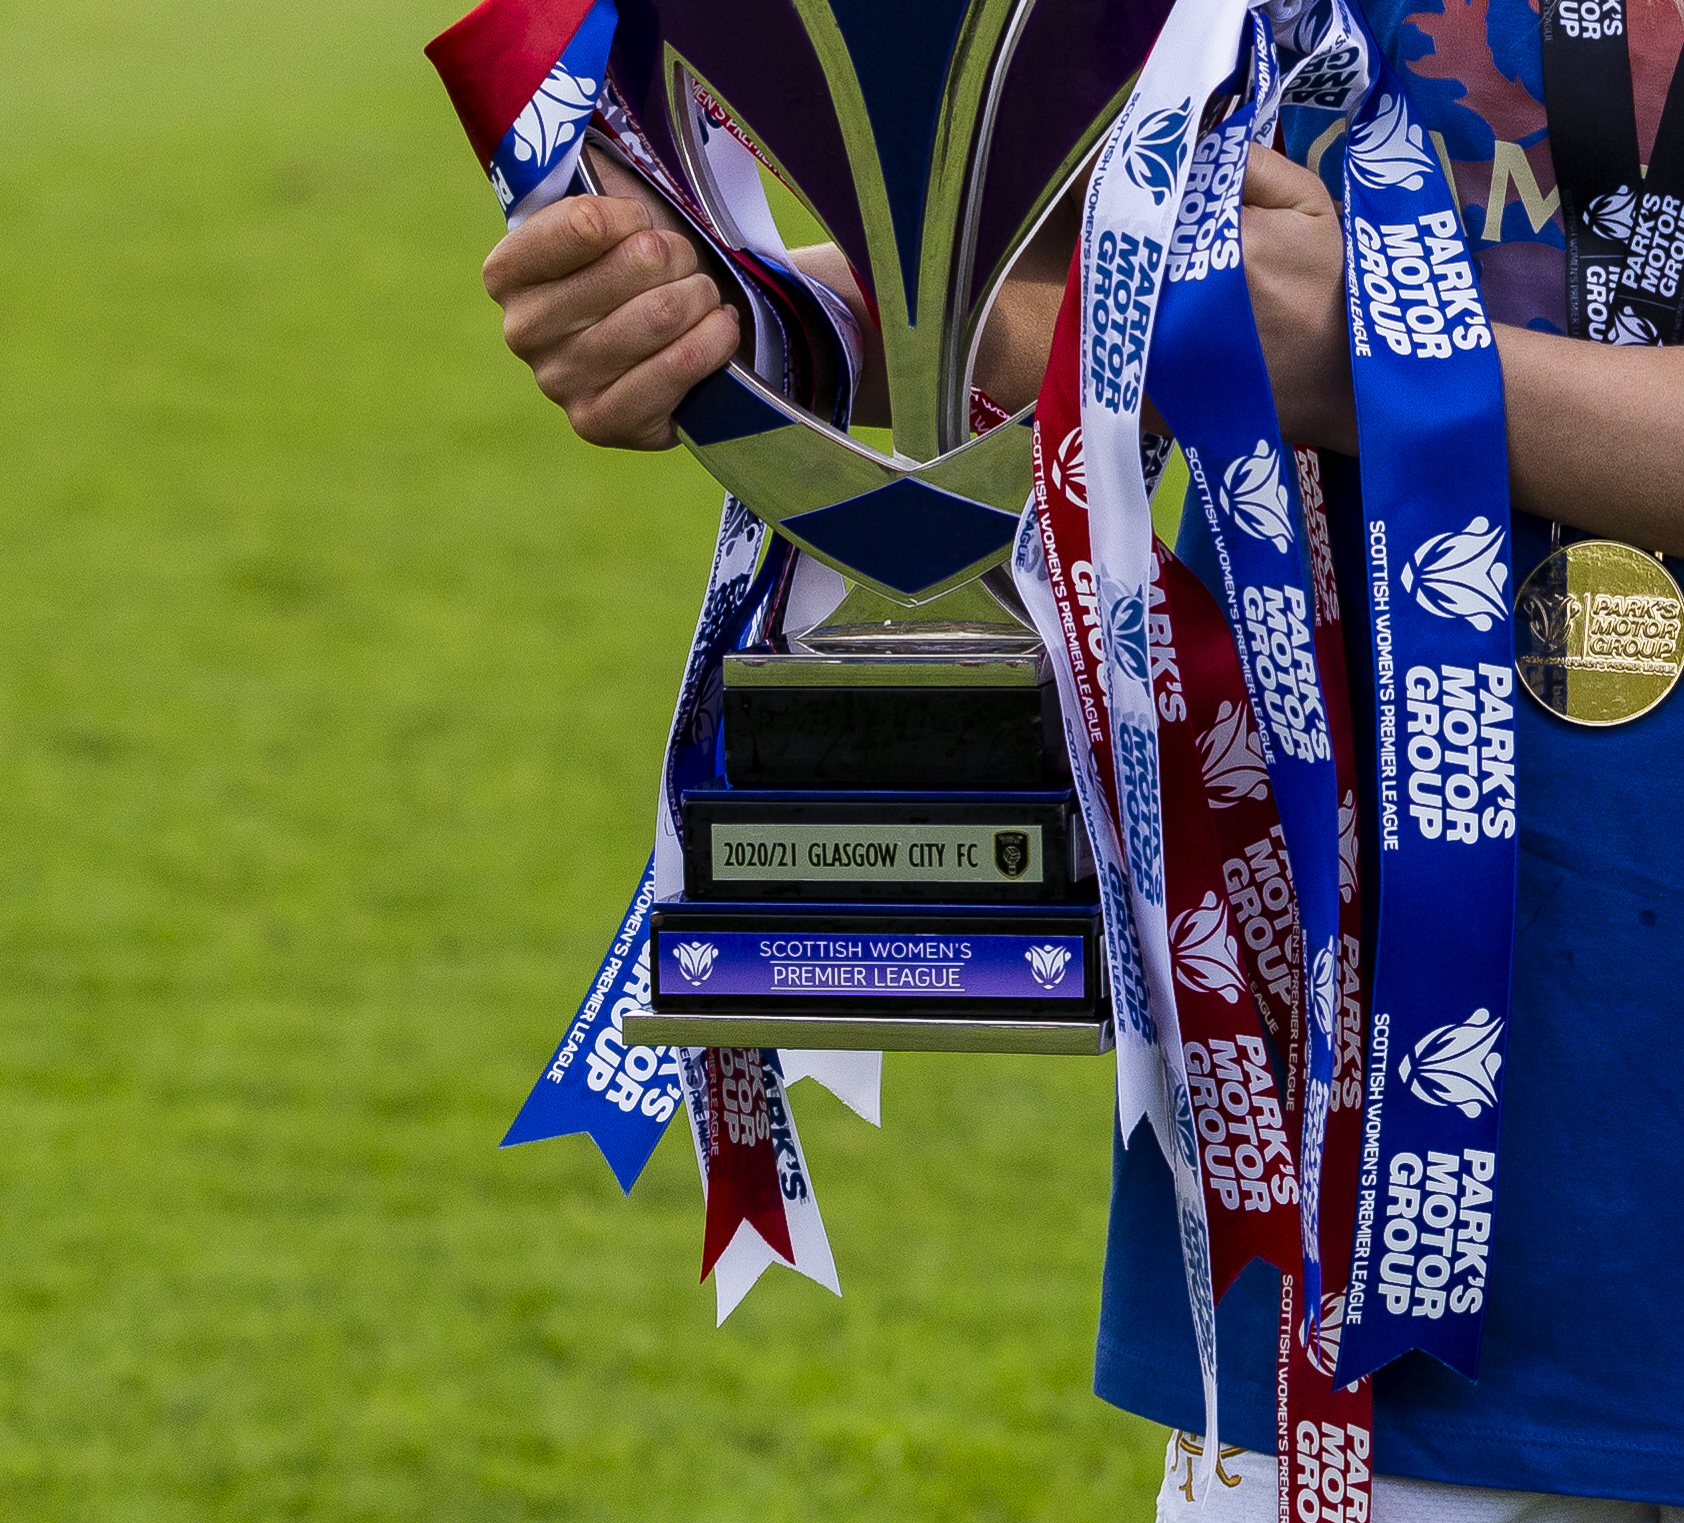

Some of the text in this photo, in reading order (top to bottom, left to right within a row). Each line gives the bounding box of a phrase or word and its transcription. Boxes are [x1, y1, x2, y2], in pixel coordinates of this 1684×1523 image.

[1097, 92, 1142, 172] SCOTTISH
[1184, 126, 1247, 281] MOTOR
[1082, 175, 1105, 261] WOMEN'S
[1166, 133, 1221, 282] GROUP
[1418, 209, 1491, 350] PARK'S
[1621, 192, 1661, 290] PARK'S
[1640, 194, 1681, 294] MOTOR
[1090, 230, 1117, 404] GROUP
[1105, 232, 1140, 415] MOTOR
[1122, 236, 1164, 415] PARK'S
[1350, 297, 1372, 358] LEAGUE
[1354, 216, 1412, 356] GROUP
[1380, 223, 1453, 359] MOTOR
[1586, 265, 1608, 343] GROU
[1033, 420, 1104, 742] SCOTTISH WOMEN'S PREMIER LEAGUE
[1185, 446, 1277, 765] SCOTTISH WOMEN'S PREMIER LEAGUE
[1306, 448, 1340, 621] PARK'S
[1243, 586, 1294, 757] GROUP
[1263, 585, 1315, 764] MOTOR
[1284, 584, 1331, 762] PARK'S
[1589, 637, 1677, 661] GROUP
[1590, 616, 1681, 640] MOTOR
[1593, 594, 1681, 620] PARK'S
[1369, 520, 1399, 852] SCOTTISH WOMEN'S PREMIER LEAGUE
[1405, 665, 1442, 840] GROUP
[1441, 664, 1479, 845] MOTOR
[1479, 662, 1516, 840] PARK'S
[723, 841, 979, 868] 2020/21 GLASGOW CITY FC
[1119, 722, 1144, 895] GROUP
[1131, 725, 1156, 907] MOTOR
[759, 941, 972, 960] SCOTTISH WOMEN'S
[1102, 888, 1115, 960] PREMIER
[1108, 861, 1141, 1040] GROUP
[1222, 858, 1292, 1005] GROUP
[1244, 838, 1292, 963] MOT
[547, 880, 654, 1084] WOMEN'S PREMIER LEAGUE
[773, 966, 961, 987] PREMIER LEAGUE
[1108, 961, 1125, 1033] LEAGUE
[1248, 973, 1279, 1035] EAGUE
[1289, 969, 1300, 1039] PREMIER
[1342, 934, 1362, 1110] PARK'S
[680, 1048, 699, 1085] EN'S
[710, 1089, 720, 1156] LEAGUE
[720, 1048, 740, 1143] OUP
[735, 1048, 755, 1147] TOR
[749, 1048, 770, 1140] RK'S
[1184, 1041, 1240, 1211] GROUP
[1208, 1038, 1271, 1213] MOTOR
[1235, 1034, 1300, 1205] PARK'S
[1286, 1042, 1299, 1112] LEAGUE
[1347, 1013, 1390, 1325] SCOTTISH WOMEN'S PREMIER LEAGUE
[1378, 1152, 1423, 1315] GROUP
[1411, 1150, 1460, 1319] MOTOR
[1449, 1148, 1495, 1314] PARK'S
[1277, 1274, 1294, 1523] SCOTTISH WOMEN'S PREMIER
[1296, 1420, 1320, 1523] GRO
[1321, 1421, 1345, 1523] MOT
[1346, 1422, 1370, 1523] PAR
